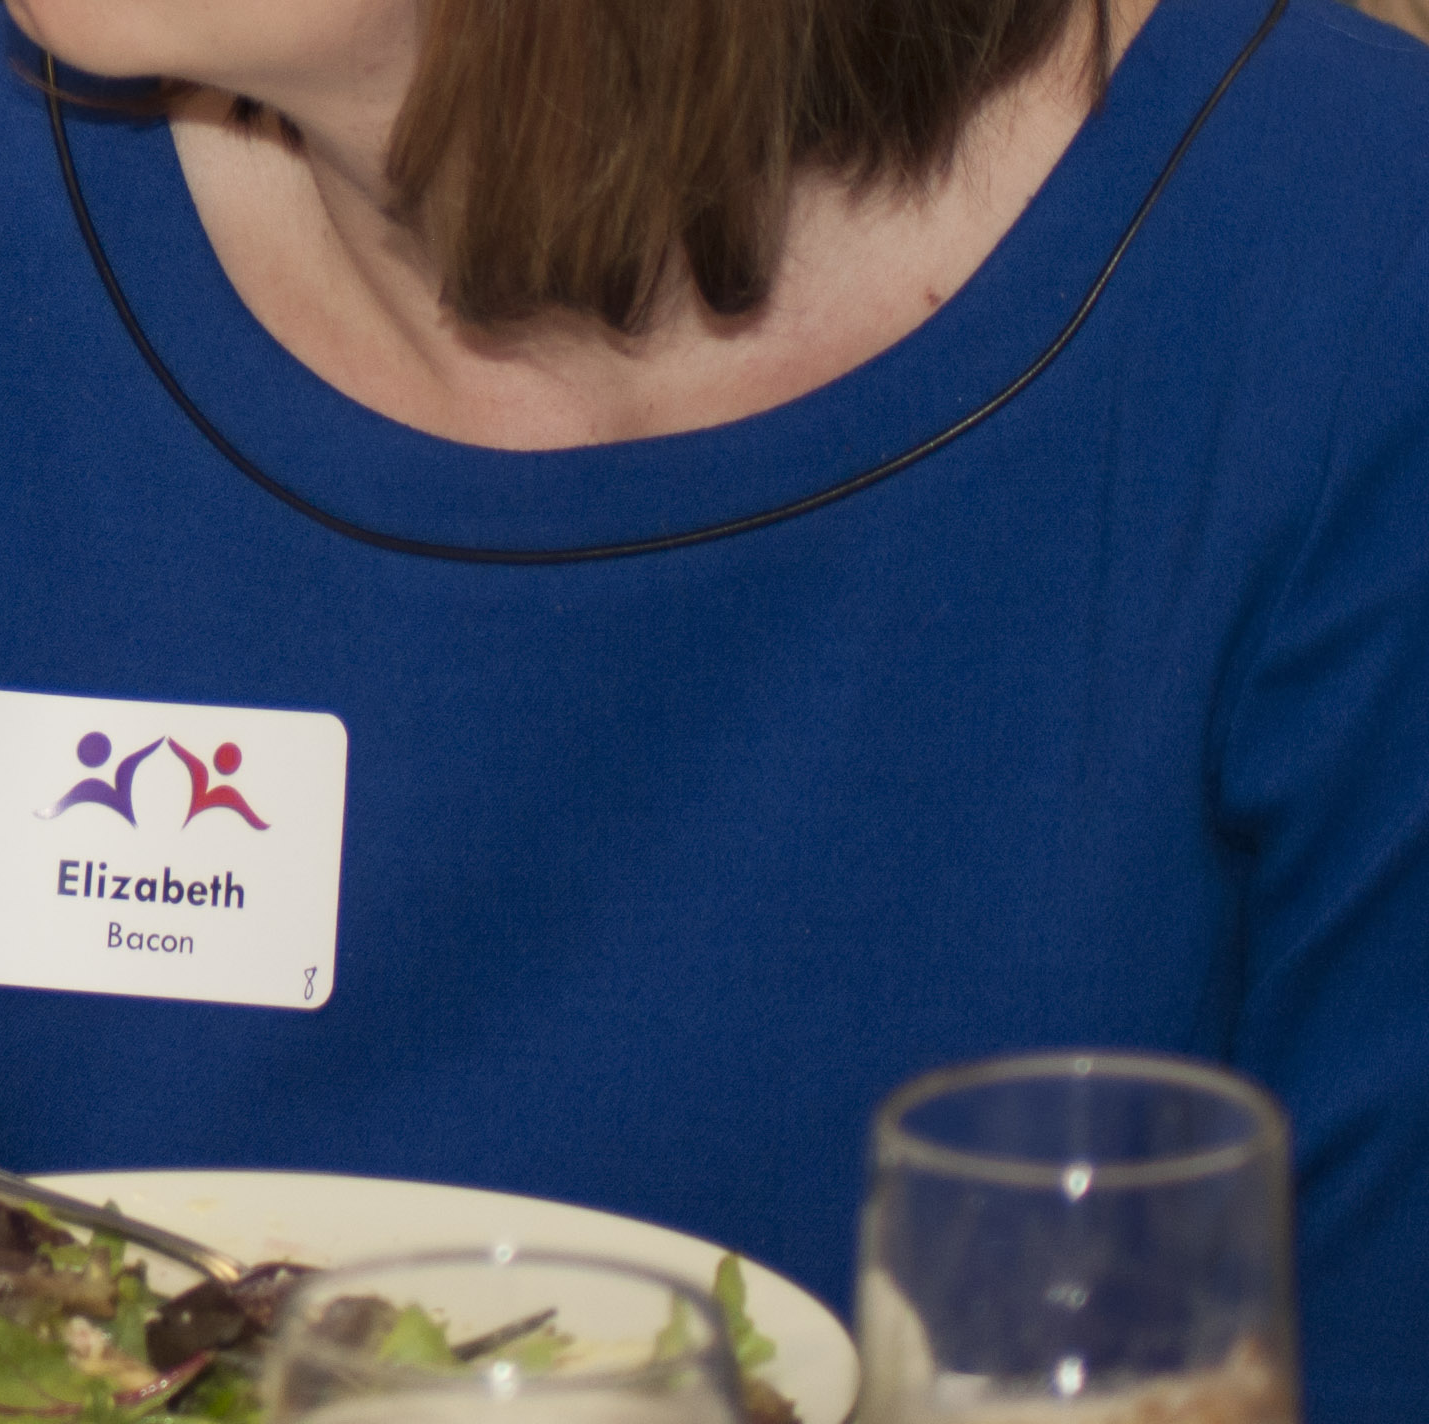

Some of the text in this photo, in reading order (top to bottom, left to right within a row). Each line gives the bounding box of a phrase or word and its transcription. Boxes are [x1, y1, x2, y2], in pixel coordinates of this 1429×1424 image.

[56, 858, 245, 909] Elizabeth
[106, 921, 194, 954] Bacon
[303, 966, 318, 1000] 8
